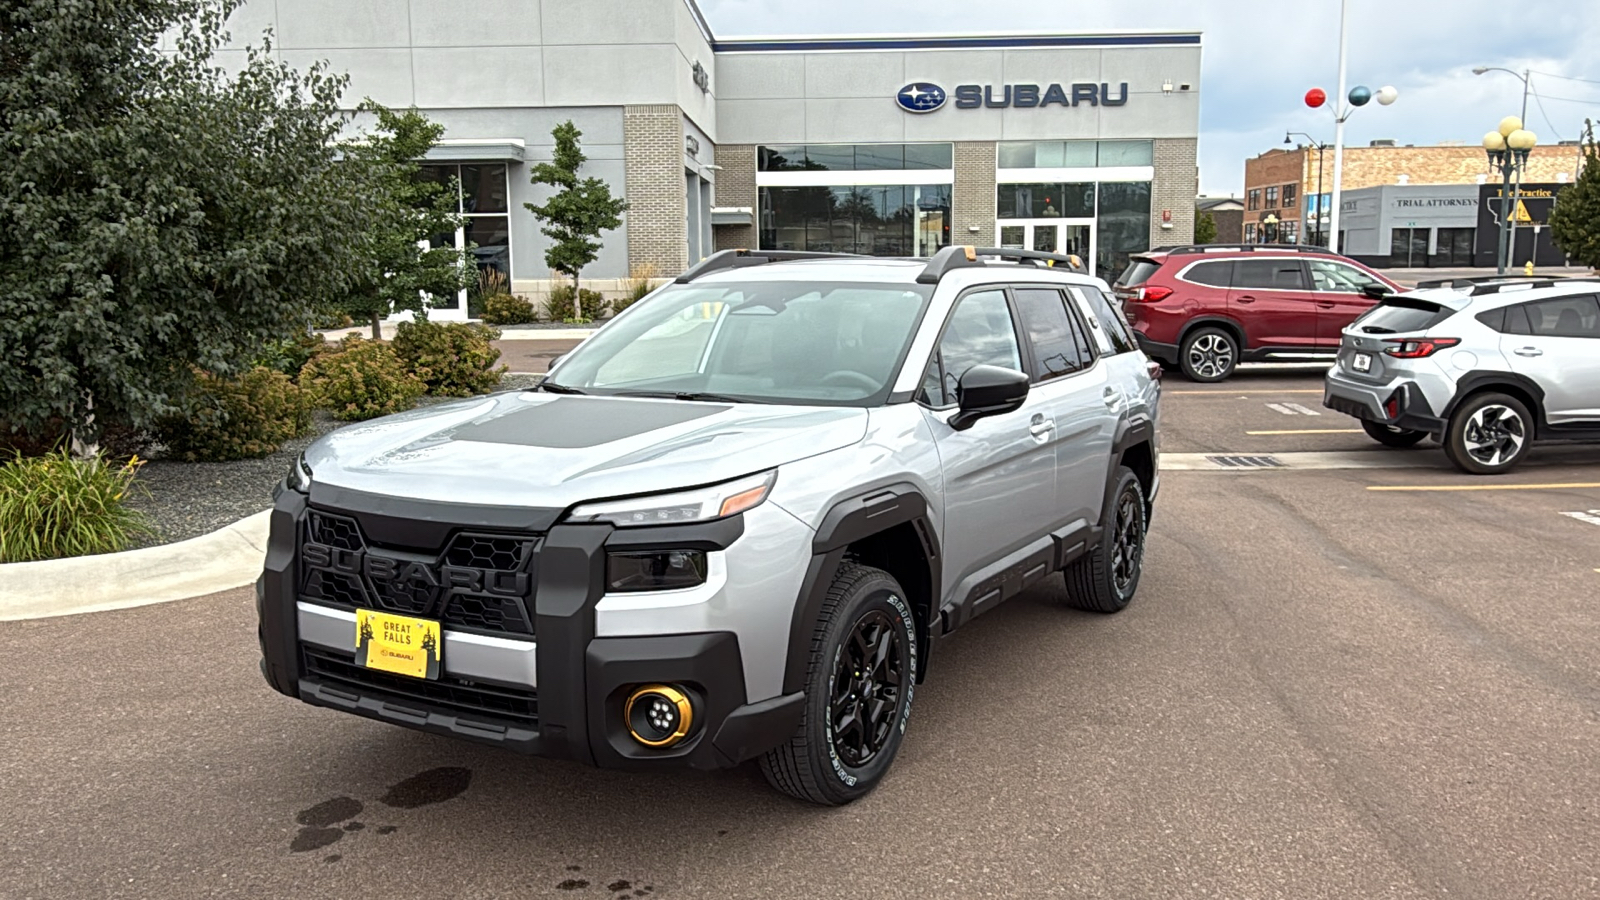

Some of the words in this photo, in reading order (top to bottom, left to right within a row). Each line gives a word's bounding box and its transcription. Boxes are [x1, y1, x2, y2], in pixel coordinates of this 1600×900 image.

[954, 82, 1129, 109] SUBARU
[1496, 189, 1514, 198] Te
[1517, 188, 1552, 198] Practice
[1397, 199, 1425, 208] TRIAL
[1427, 198, 1480, 208] ATTORNEYS
[302, 542, 529, 597] SUBARU
[383, 621, 411, 634] GREAT
[384, 631, 411, 645] FALLS
[388, 651, 414, 661] SUBARU
